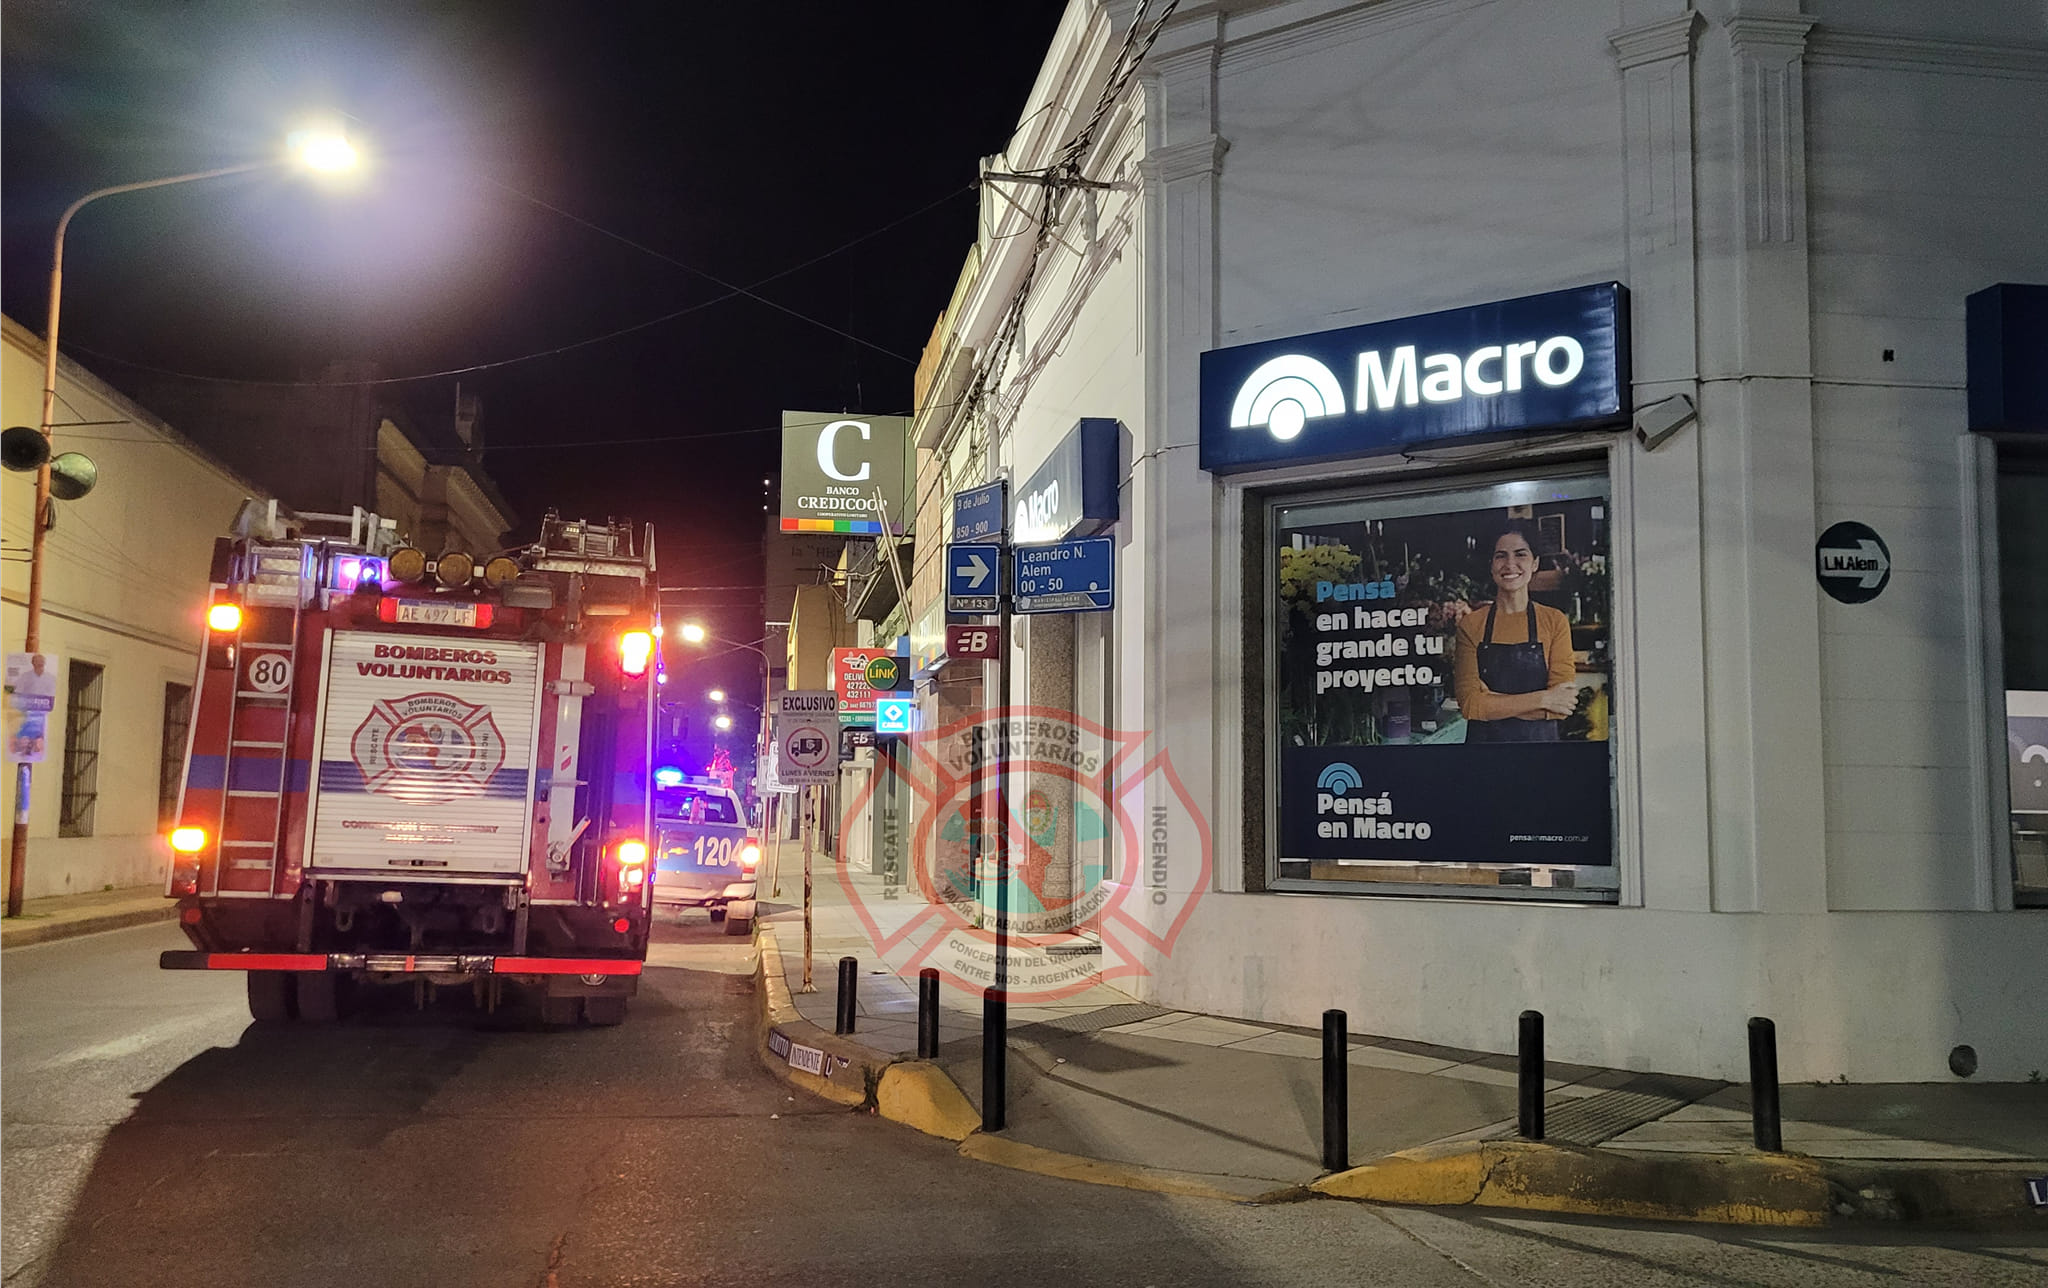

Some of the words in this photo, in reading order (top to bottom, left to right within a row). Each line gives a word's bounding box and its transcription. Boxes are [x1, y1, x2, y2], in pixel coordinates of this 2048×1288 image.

[1355, 335, 1584, 412] Macro
[817, 420, 870, 481] C
[826, 486, 859, 495] BANCO
[957, 500, 962, 510] 9
[963, 497, 972, 510] de
[973, 493, 990, 507] Julio
[1028, 479, 1058, 529] Macro
[956, 525, 969, 539] 850
[975, 520, 989, 534] 900
[1021, 548, 1070, 563] Leandro
[1073, 546, 1086, 558] N.
[1021, 565, 1051, 577] Alem
[1021, 580, 1035, 593] 00
[1049, 578, 1063, 591] 50
[1316, 574, 1396, 602] Pensá
[970, 600, 988, 608] 133
[402, 609, 418, 620] AE
[424, 611, 448, 623] 497
[454, 613, 471, 625] LF
[1316, 612, 1348, 631] en
[1354, 606, 1429, 629] hacer
[374, 644, 497, 665] BOMBEROS
[1316, 633, 1409, 666] grande
[1415, 634, 1443, 655] tu
[255, 660, 287, 685] 80
[357, 662, 512, 684] VOLUNTARIOS
[844, 672, 865, 681] DELIVE
[1316, 664, 1441, 694] proyecto.
[403, 705, 463, 719] VOLUNTARIOS
[408, 697, 457, 709] BOMBEROS
[782, 697, 835, 711] EXCLUSIVO
[1317, 792, 1392, 815] Pensá
[1317, 821, 1347, 838] en
[1353, 817, 1431, 839] Macro
[1509, 834, 1589, 843] pensaenmacro.com.ar
[694, 836, 745, 867] 1204
